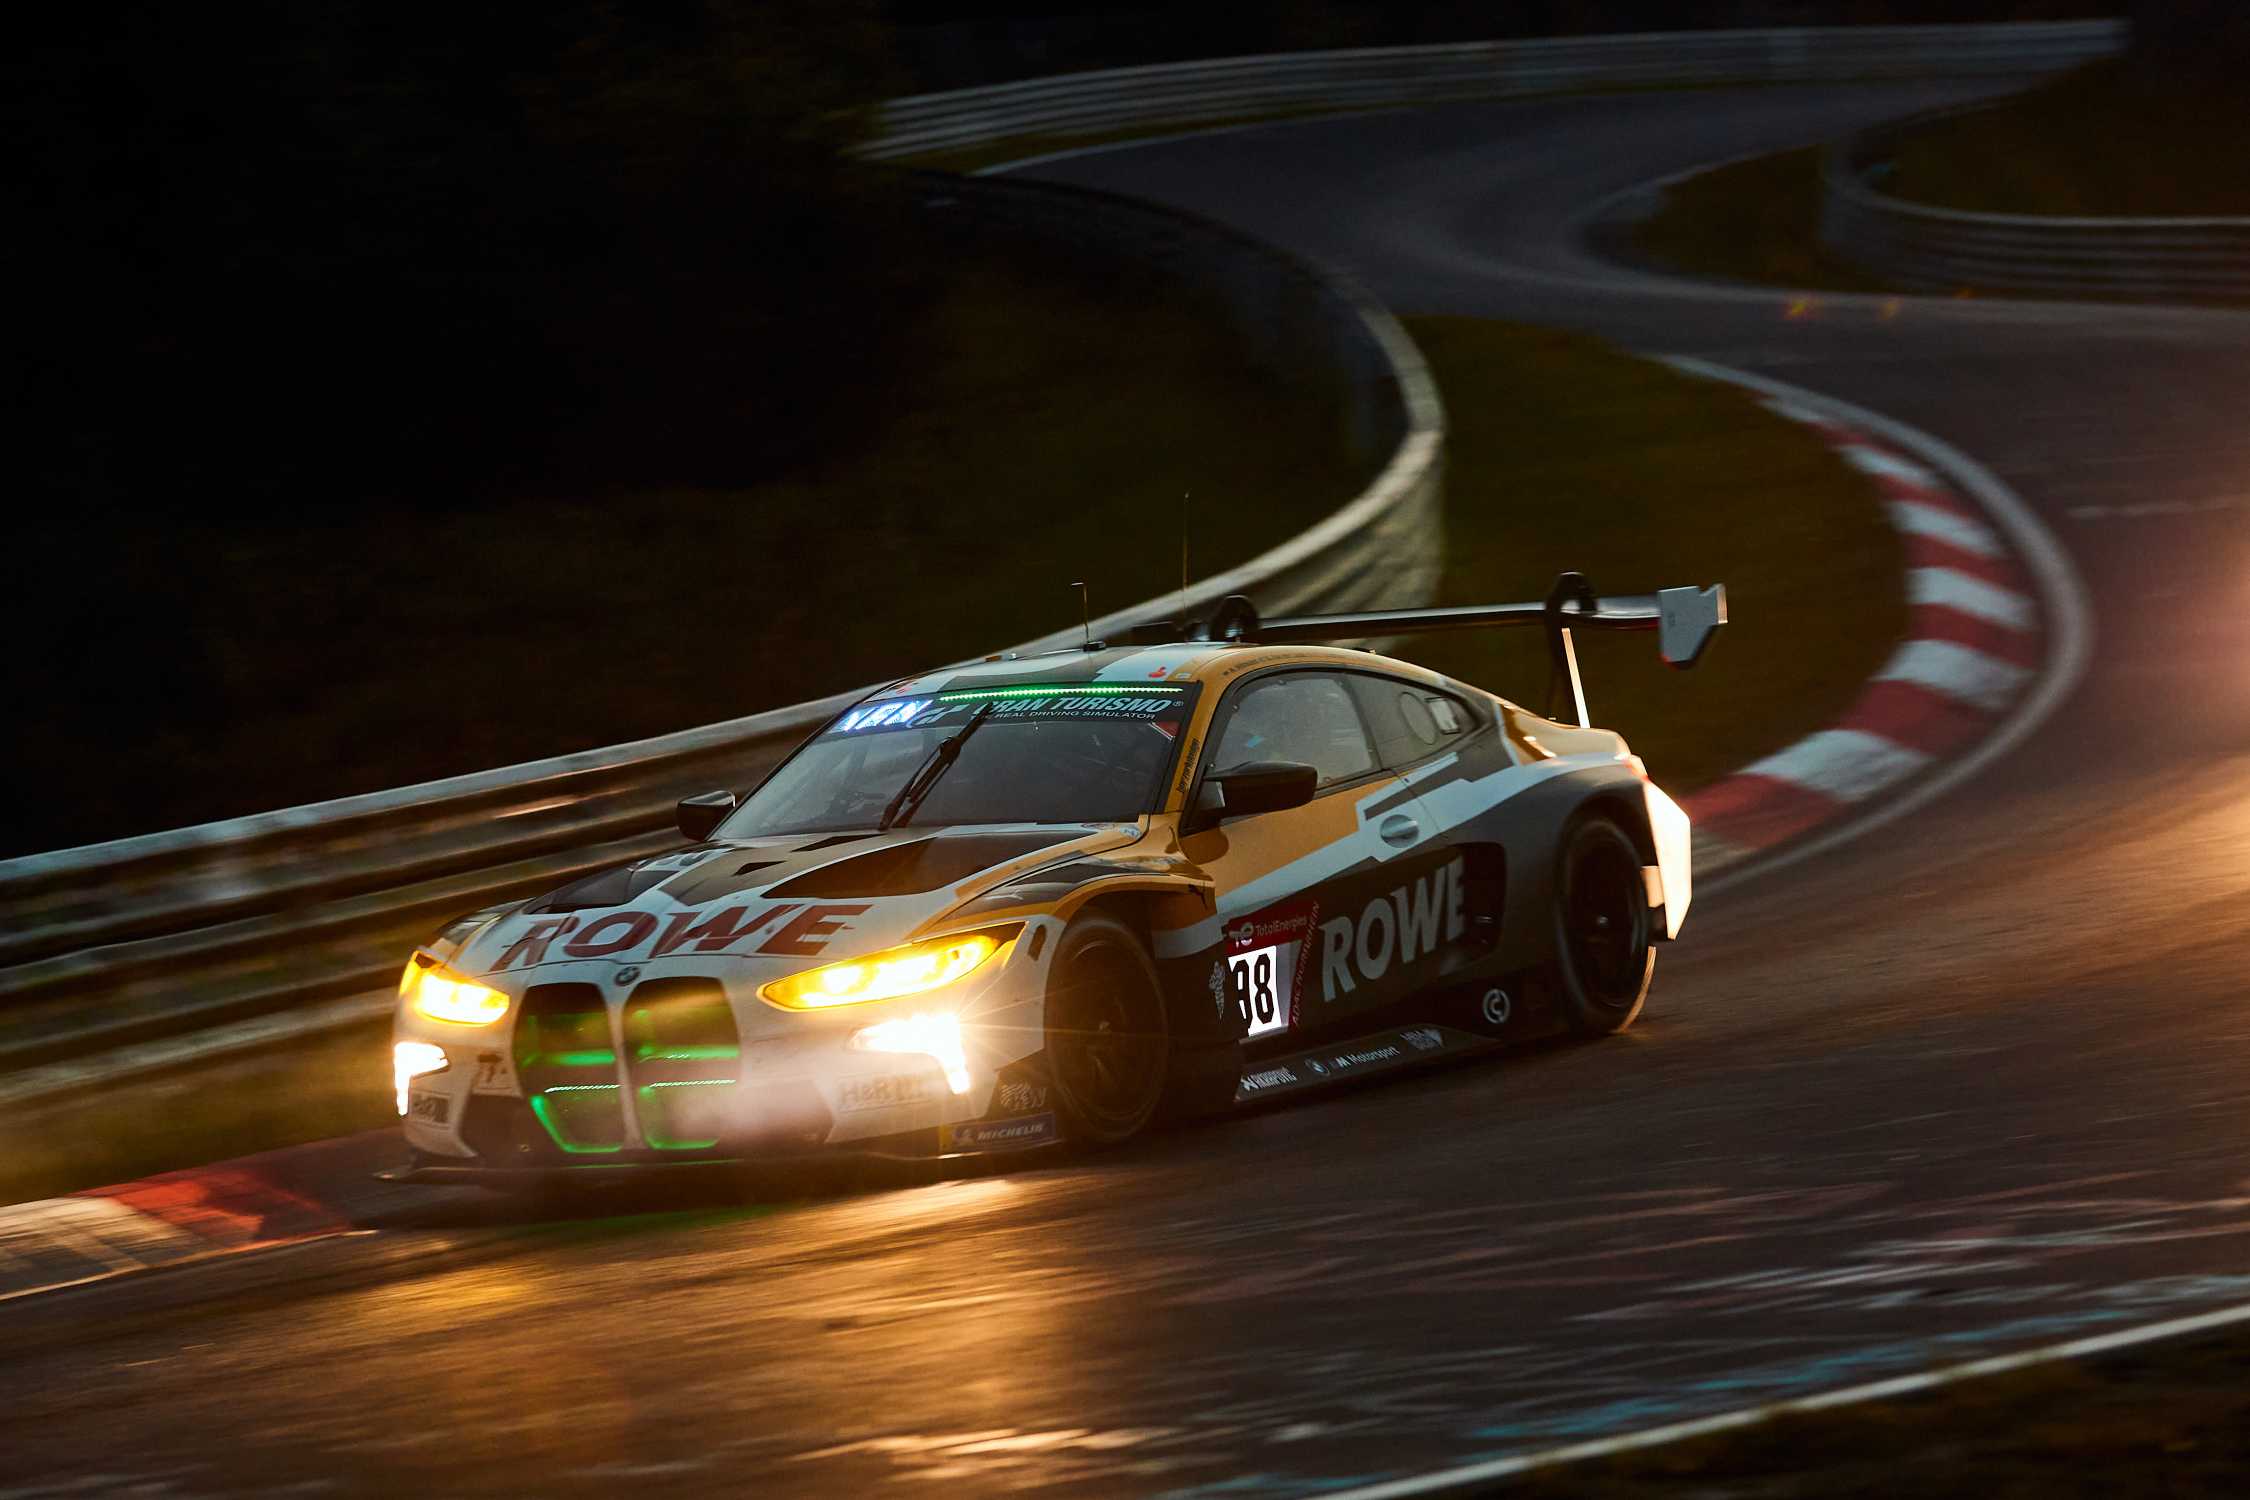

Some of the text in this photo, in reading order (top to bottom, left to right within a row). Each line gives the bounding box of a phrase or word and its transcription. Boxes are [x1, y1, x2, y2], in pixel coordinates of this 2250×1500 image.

[993, 711, 1025, 719] REAL
[1029, 710, 1080, 718] DRIVING
[1082, 711, 1156, 720] SIMULATOR
[489, 903, 873, 972] ROWE
[1318, 855, 1465, 1003] ROWE
[977, 1123, 1044, 1141] MICHELIN
